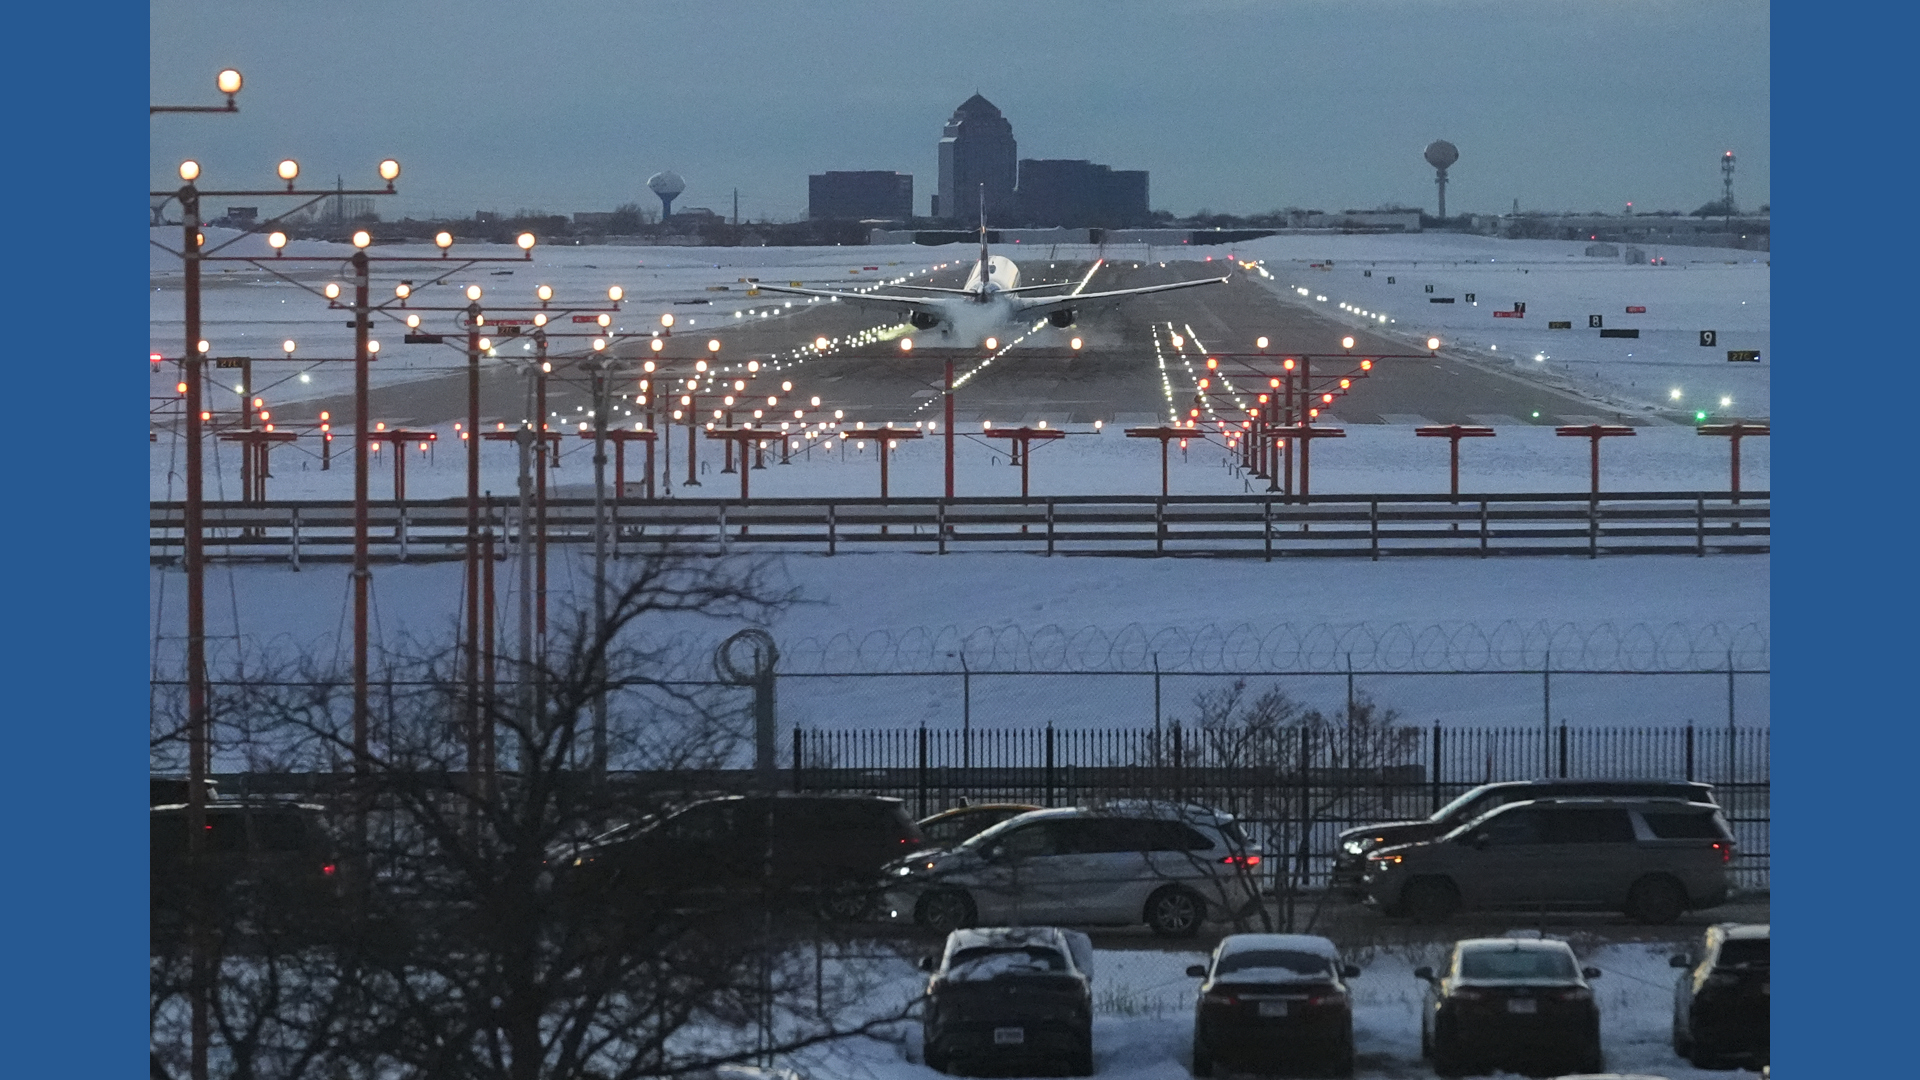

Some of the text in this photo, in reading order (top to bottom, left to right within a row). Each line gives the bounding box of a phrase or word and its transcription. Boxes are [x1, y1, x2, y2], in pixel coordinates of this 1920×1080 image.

[1468, 294, 1473, 302] 6
[1517, 302, 1522, 313] 7
[1592, 316, 1600, 327] 8
[1703, 331, 1713, 345] 9
[1732, 352, 1752, 361] 27C
